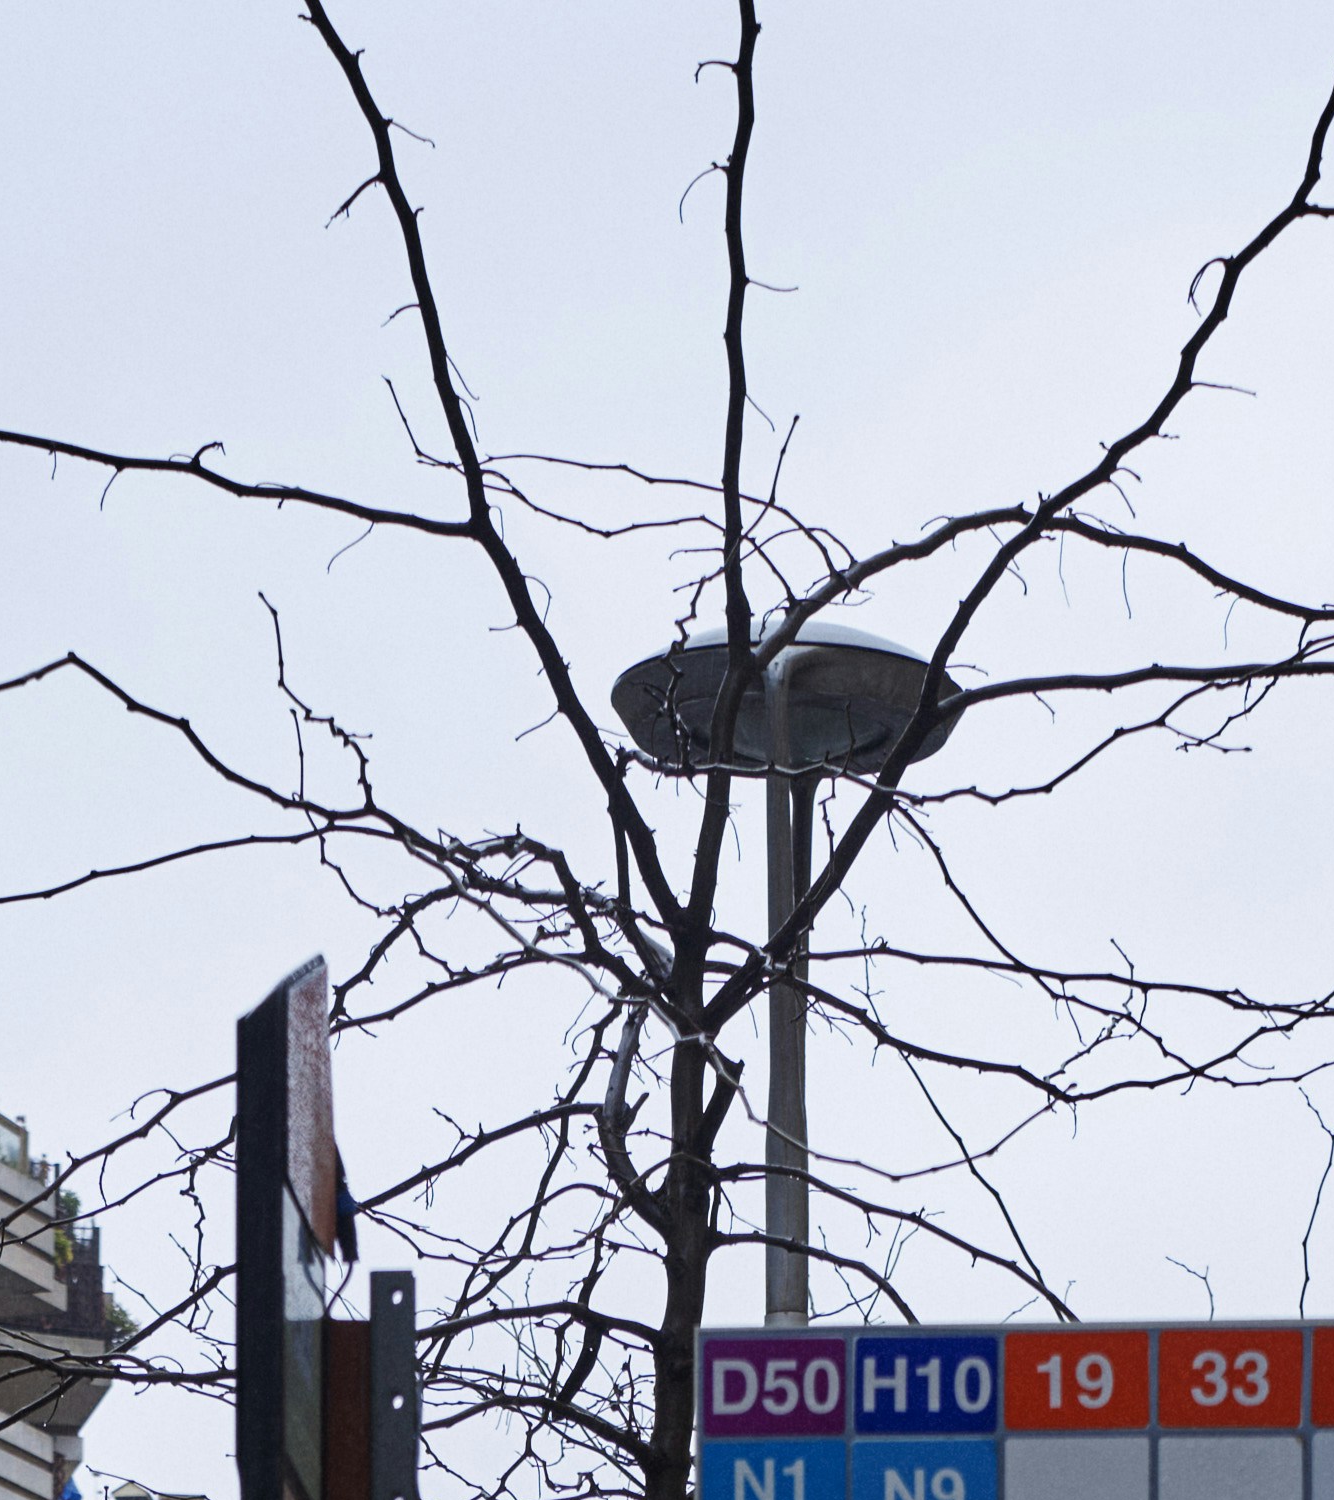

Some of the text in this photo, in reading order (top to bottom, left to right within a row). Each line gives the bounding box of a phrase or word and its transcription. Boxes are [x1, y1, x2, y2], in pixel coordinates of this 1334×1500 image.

[712, 1357, 840, 1416] D50
[862, 1355, 993, 1414] H10
[1036, 1352, 1115, 1410] 19
[1189, 1349, 1271, 1408] 33
